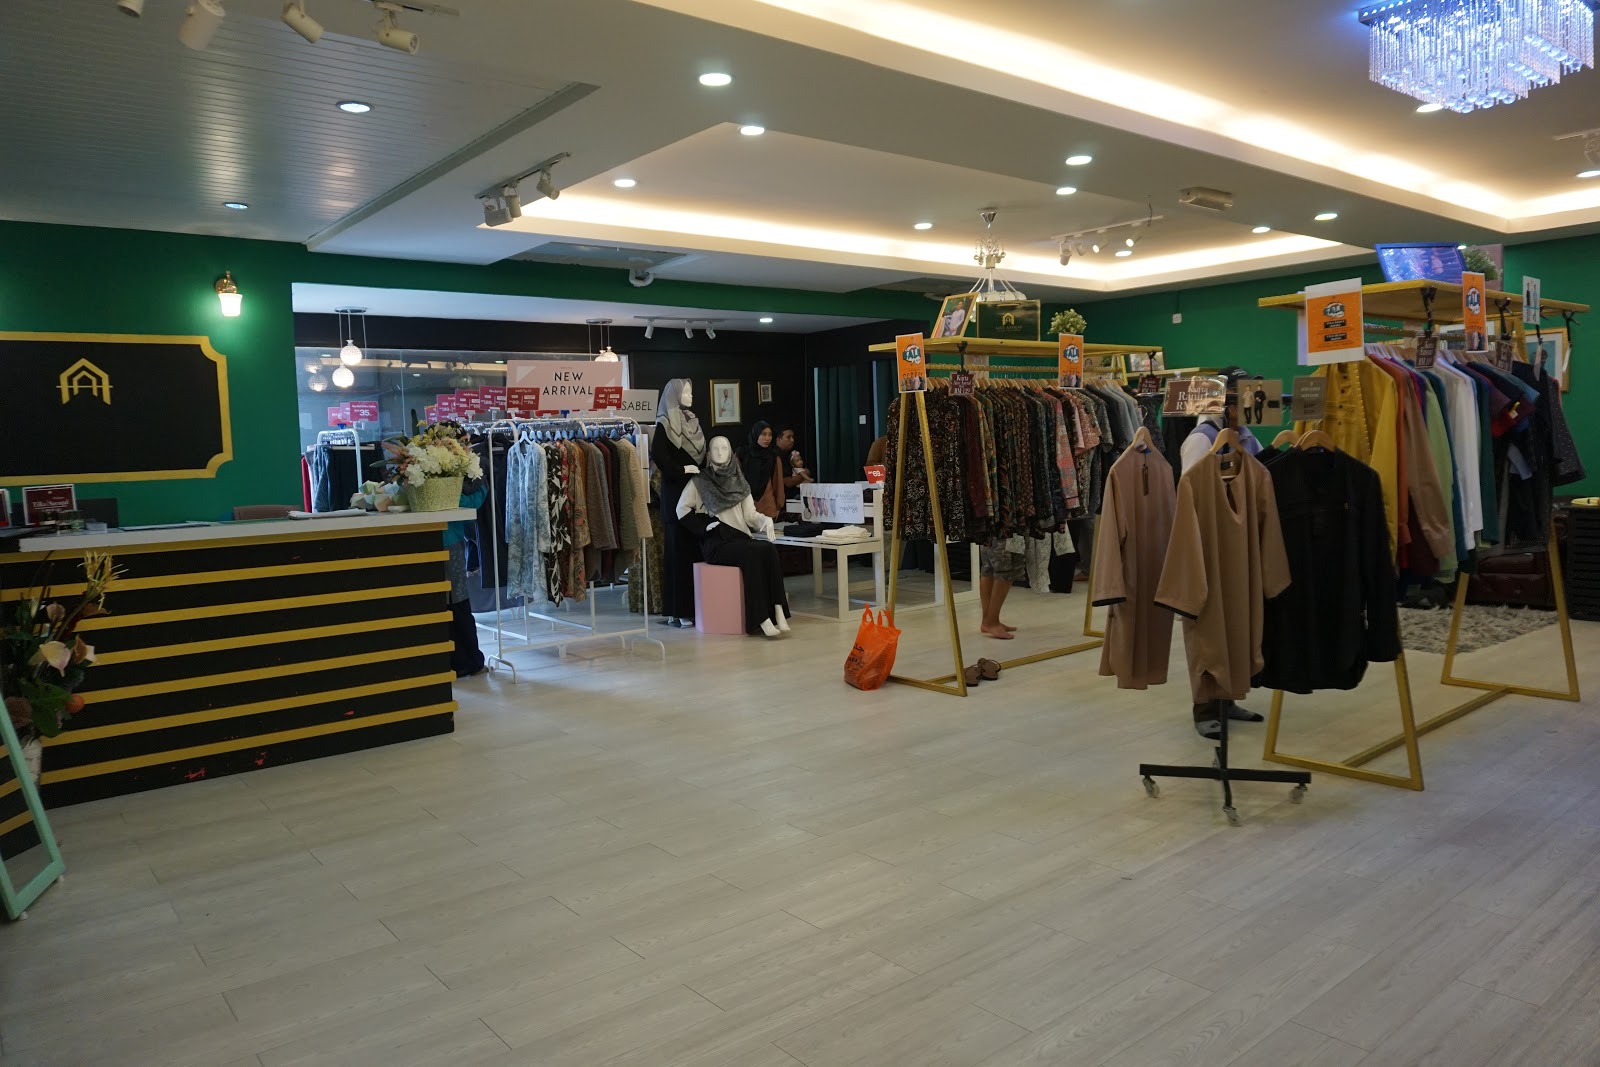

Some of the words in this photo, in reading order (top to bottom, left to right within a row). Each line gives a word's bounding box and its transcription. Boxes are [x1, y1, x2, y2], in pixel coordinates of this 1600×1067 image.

[554, 371, 584, 382] NEW
[542, 385, 594, 396] ARRIVAL
[621, 401, 652, 411] SABEL
[359, 409, 370, 417] 35
